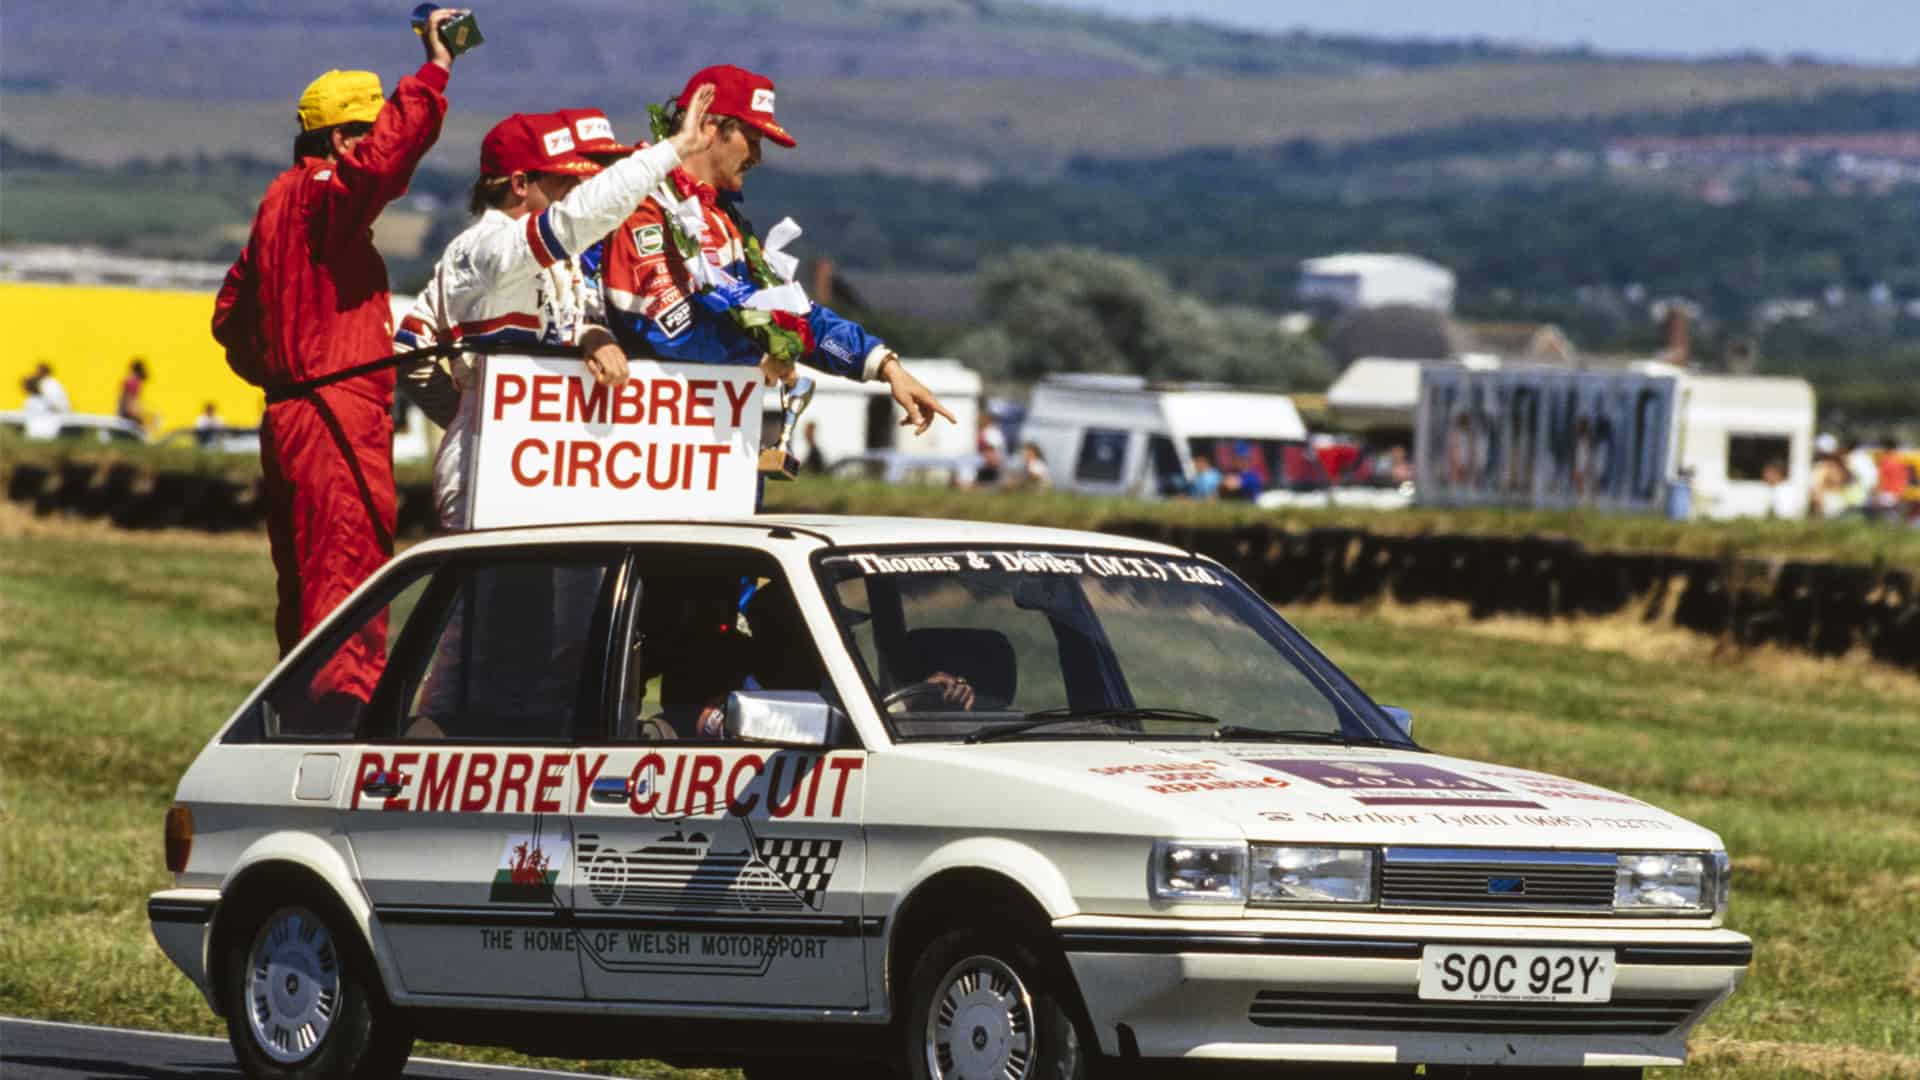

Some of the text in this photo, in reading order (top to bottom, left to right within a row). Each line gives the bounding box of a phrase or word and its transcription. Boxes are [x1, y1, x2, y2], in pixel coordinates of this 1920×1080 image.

[493, 373, 757, 427] PEMBREY
[511, 438, 731, 491] CIRCUIT
[848, 553, 961, 574] Thomas
[966, 551, 991, 570] &
[993, 551, 1082, 574] Davies
[351, 752, 864, 818] PEMBREY CIRCUIT
[1305, 811, 1418, 828] Merthyr
[480, 929, 827, 960] THE HOME OF WELSH MOTORSPORT
[1441, 953, 1600, 995] SOC 92Y
